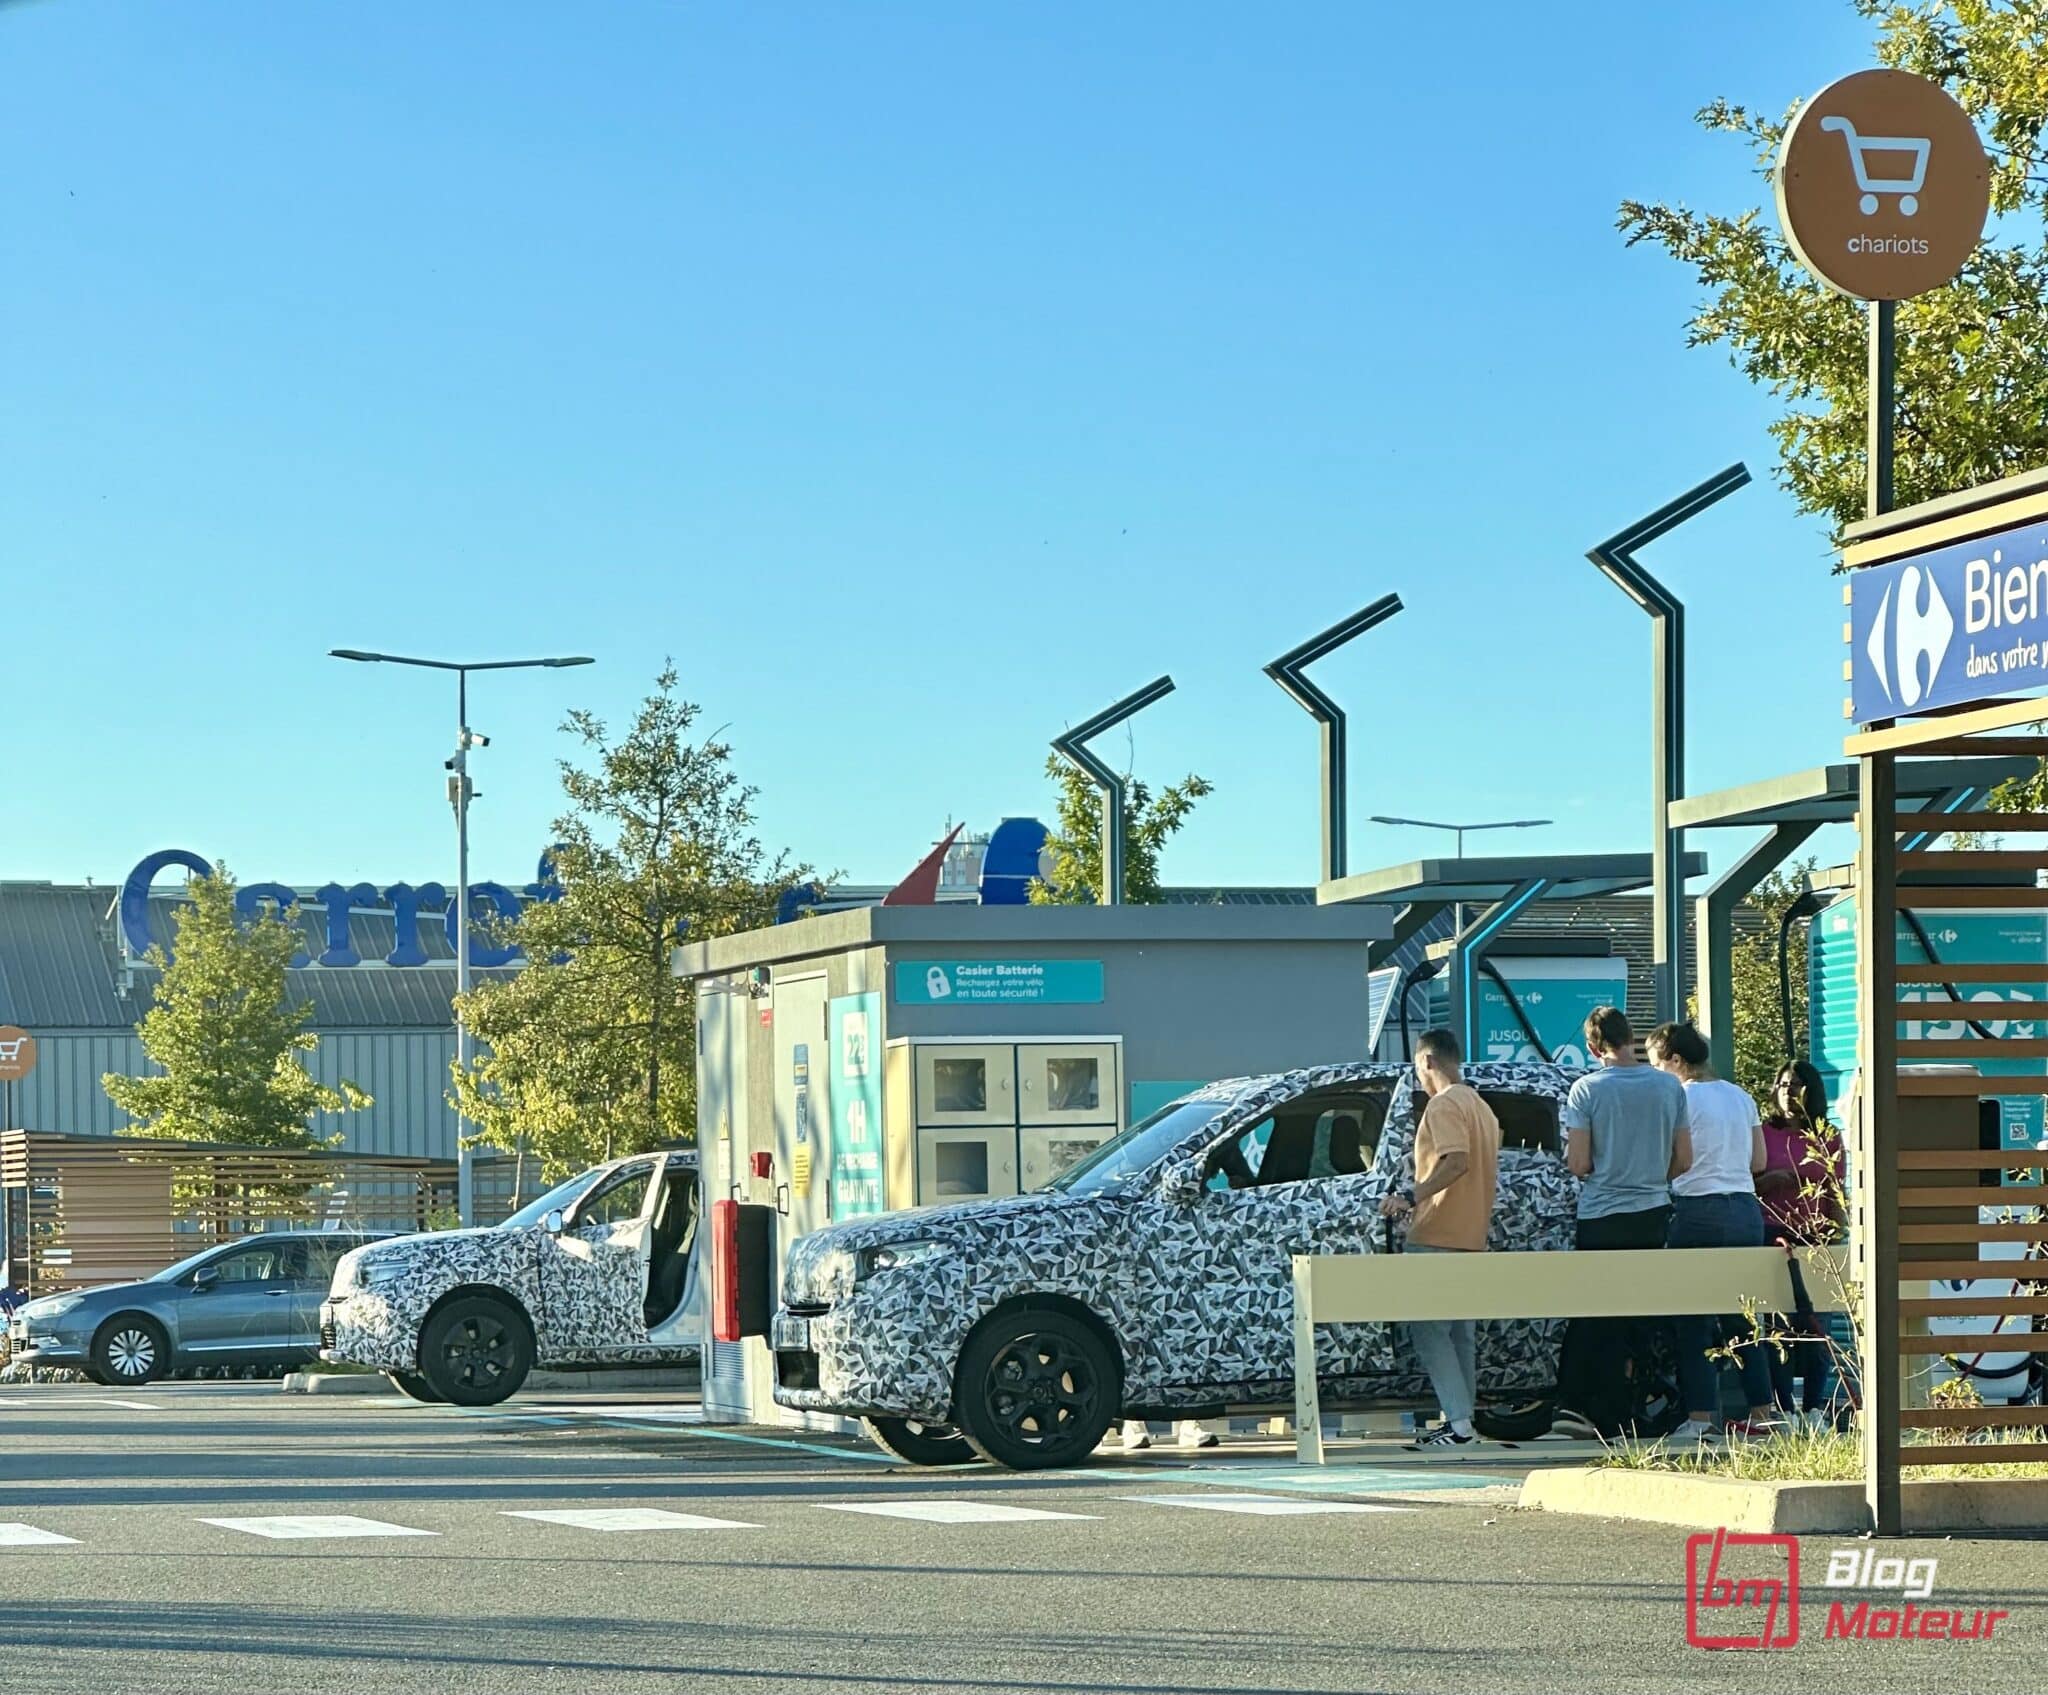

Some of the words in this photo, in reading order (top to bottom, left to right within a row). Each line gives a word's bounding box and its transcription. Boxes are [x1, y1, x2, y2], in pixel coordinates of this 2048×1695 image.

[1847, 233, 1929, 255] chariots
[1965, 548, 2048, 634] Bien
[1966, 643, 1999, 678] dans
[2001, 636, 2038, 672] votre
[956, 965, 993, 975] Casier
[996, 964, 1043, 975] Batterie
[956, 978, 1000, 988] Rechargez
[1002, 979, 1024, 987] votre
[1026, 978, 1044, 987] vélo
[956, 990, 970, 998] en
[972, 988, 997, 998] toute
[999, 988, 1038, 998] sécurité
